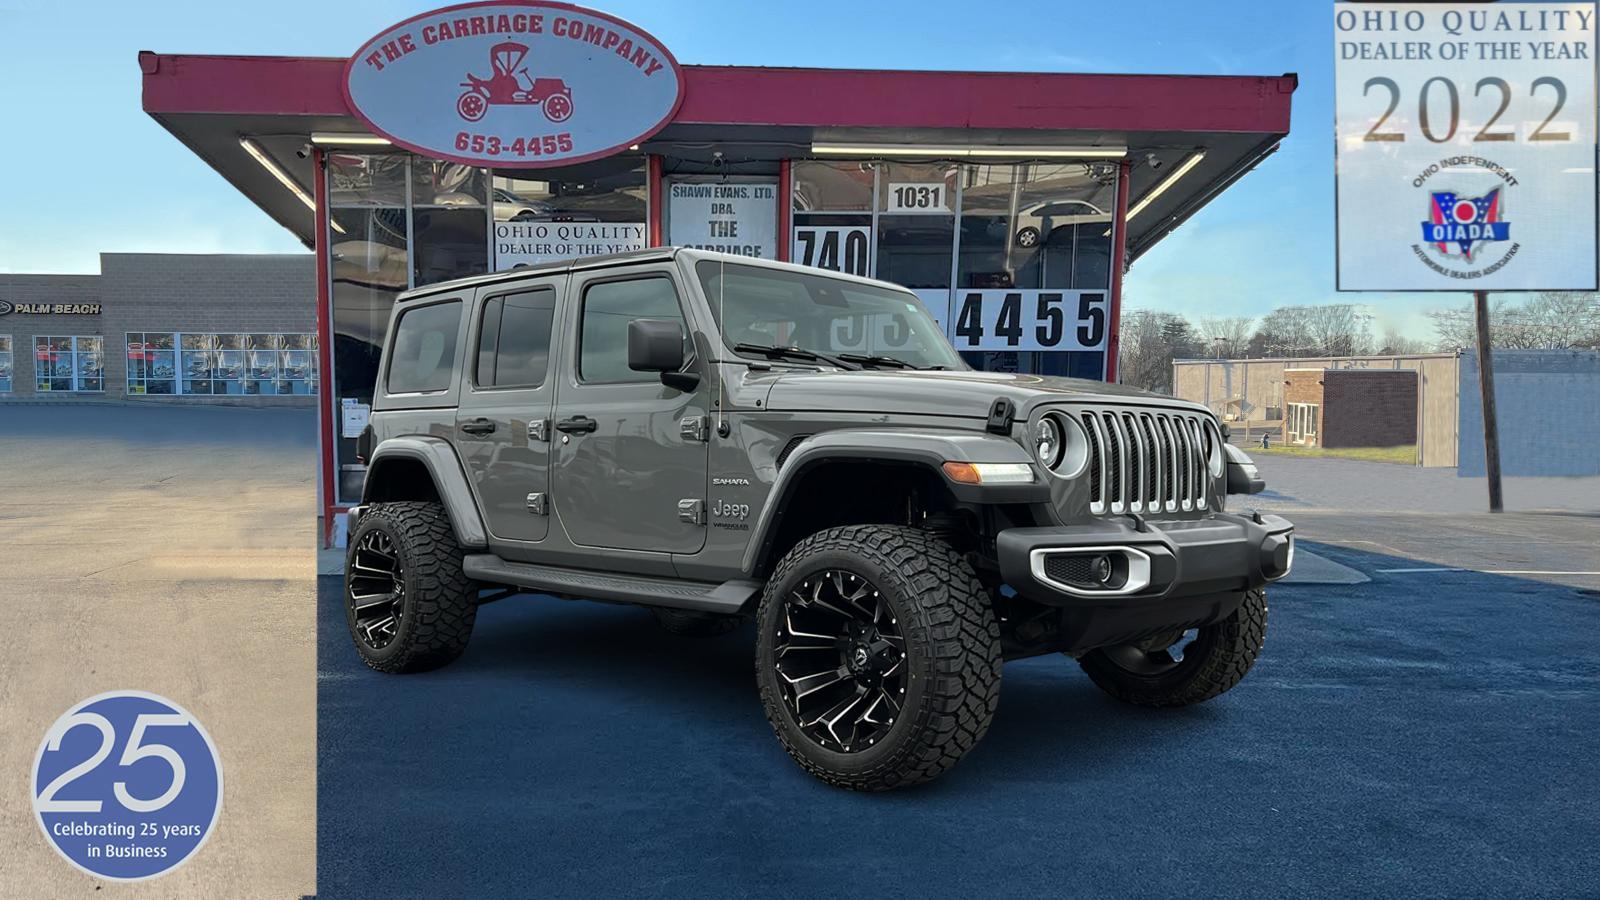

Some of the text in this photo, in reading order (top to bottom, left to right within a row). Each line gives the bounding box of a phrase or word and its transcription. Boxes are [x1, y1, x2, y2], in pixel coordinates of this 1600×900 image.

[1336, 10, 1593, 36] OHIO QUALITY
[365, 14, 664, 79] THE CARRIAGE COMPANY
[1340, 42, 1589, 60] DEALER OF THE YEAR
[1362, 76, 1571, 143] 2022
[454, 131, 573, 157] 653-4455
[1412, 156, 1519, 188] OHIO INDEPENDENT
[672, 185, 712, 199] SHAWN
[754, 187, 775, 200] LTD.
[894, 186, 940, 209] 1031
[711, 203, 736, 215] DBA.
[497, 226, 644, 240] OHIO QUALITY
[708, 220, 738, 238] THE
[1432, 224, 1495, 240] OIADA
[500, 243, 551, 255] DEALER
[555, 243, 574, 255] OF
[576, 243, 604, 255] THE
[797, 230, 868, 277] 740
[1411, 242, 1521, 280] AUTOMOBILE DEALERS ASSOCIATION
[14, 303, 100, 314] PALM BEACH
[955, 293, 1105, 347] 4455
[712, 478, 750, 486] SAHARA
[712, 499, 750, 521] Jeep
